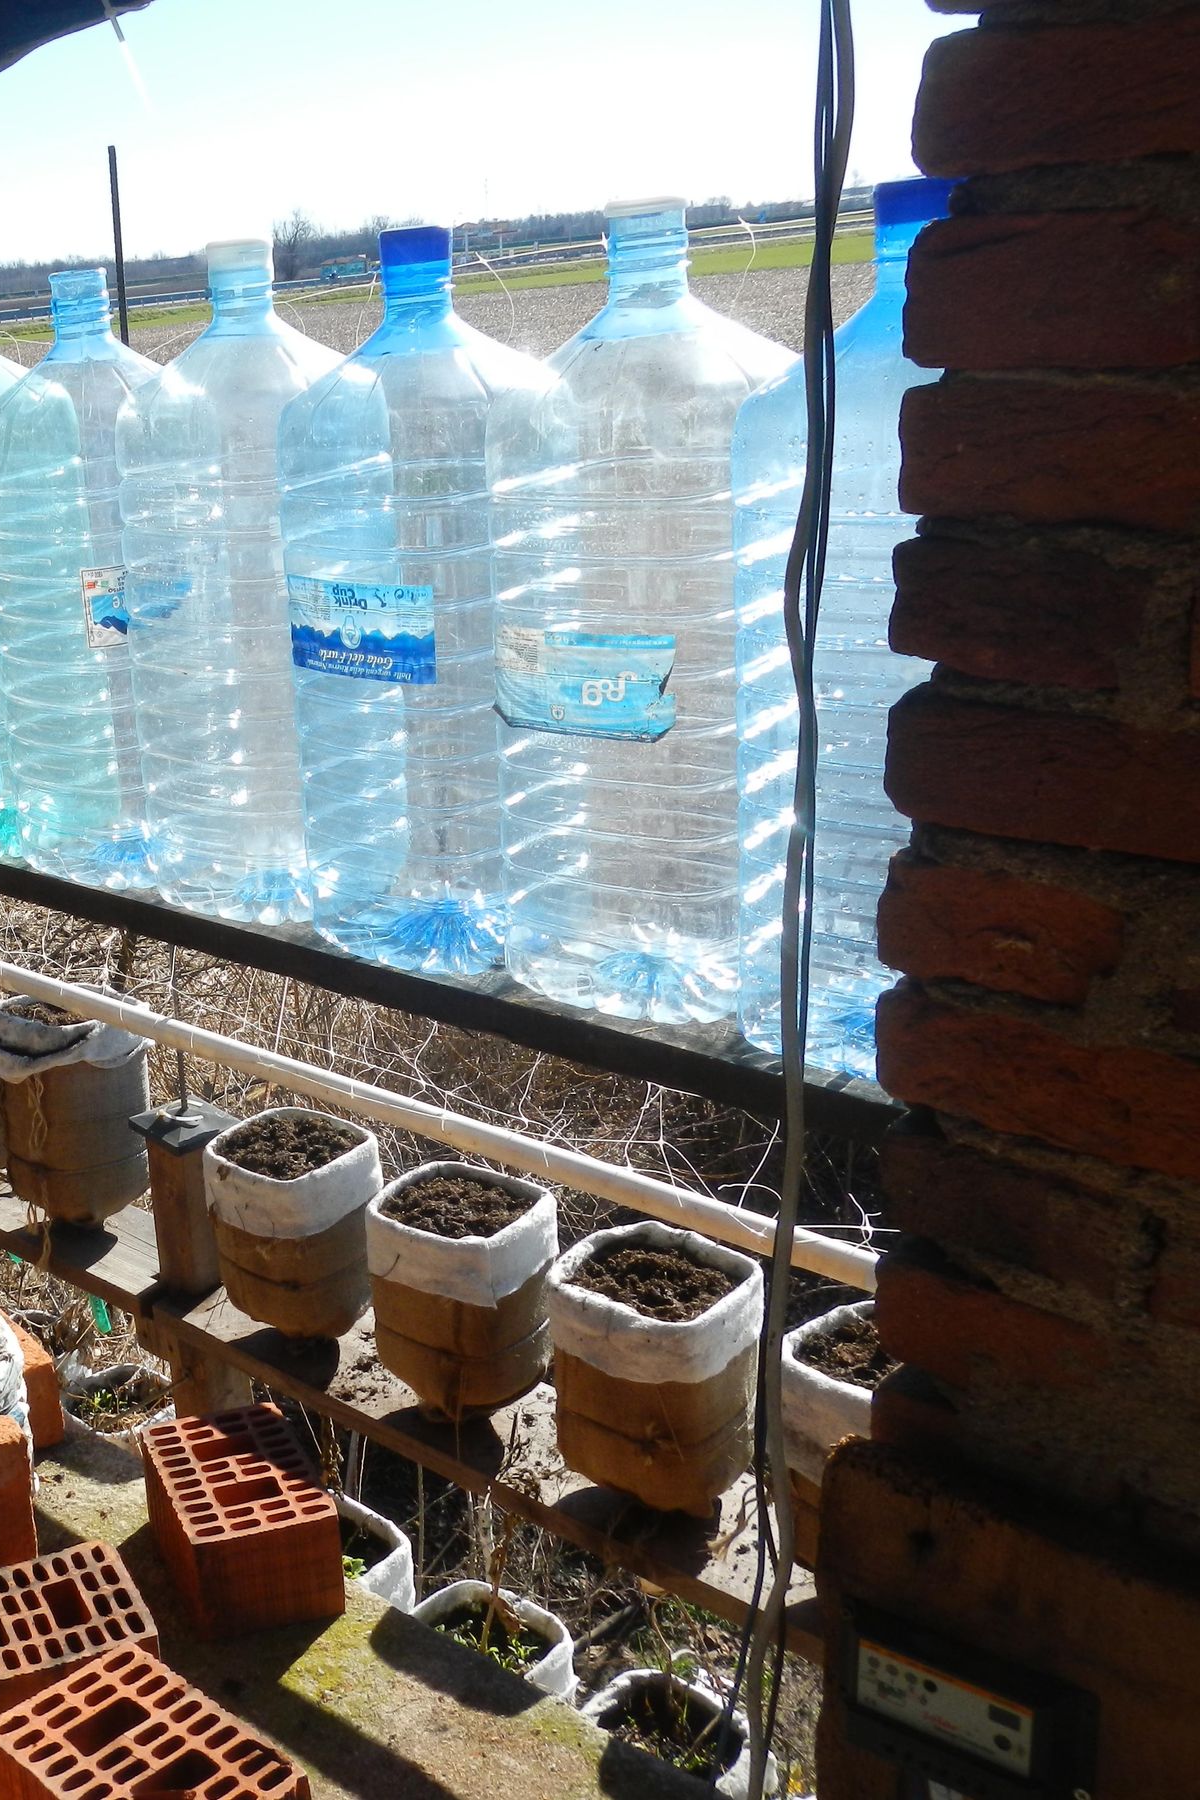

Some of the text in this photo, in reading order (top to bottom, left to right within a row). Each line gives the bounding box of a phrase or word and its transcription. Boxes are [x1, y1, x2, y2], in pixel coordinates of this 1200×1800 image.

[331, 583, 356, 599] Cup
[332, 595, 368, 610] Drink
[347, 652, 365, 665] del
[367, 654, 393, 670] Gola
